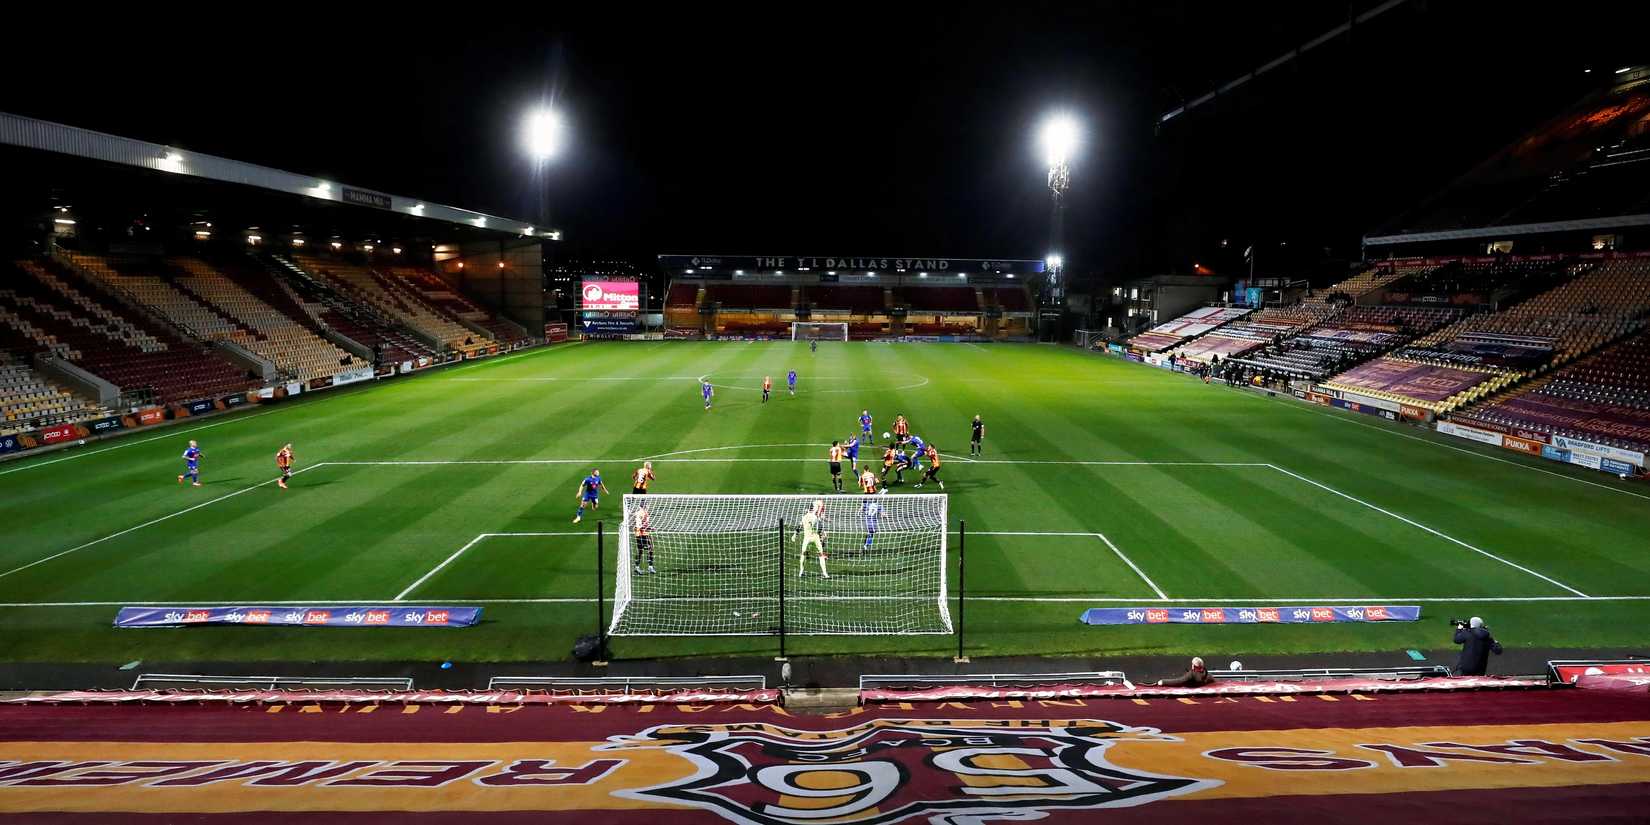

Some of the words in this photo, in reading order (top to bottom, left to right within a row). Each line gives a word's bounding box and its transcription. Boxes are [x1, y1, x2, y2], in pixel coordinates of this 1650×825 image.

[756, 258, 785, 267] THE
[812, 259, 819, 267] L
[826, 258, 888, 269] DALLAS
[895, 260, 949, 270] STAND
[1505, 438, 1530, 451] PUKKA
[164, 612, 184, 624] sky
[187, 612, 208, 622] bet
[224, 613, 245, 623] sky
[248, 613, 268, 623] bet
[285, 612, 304, 624] sky
[308, 613, 327, 623] bet
[345, 612, 365, 623] sky
[368, 613, 387, 623] bet
[405, 612, 424, 623] sky
[428, 613, 447, 622] bet
[1127, 610, 1145, 621] sky
[1148, 610, 1166, 620] bet
[1183, 610, 1201, 621] sky
[1203, 610, 1222, 619] bet
[1239, 610, 1257, 620] sky
[1259, 610, 1278, 619] bet
[1293, 609, 1311, 619] sky
[1313, 609, 1332, 619] bet
[1347, 608, 1364, 618] sky
[1367, 608, 1385, 618] bet
[983, 719, 1078, 728] THE
